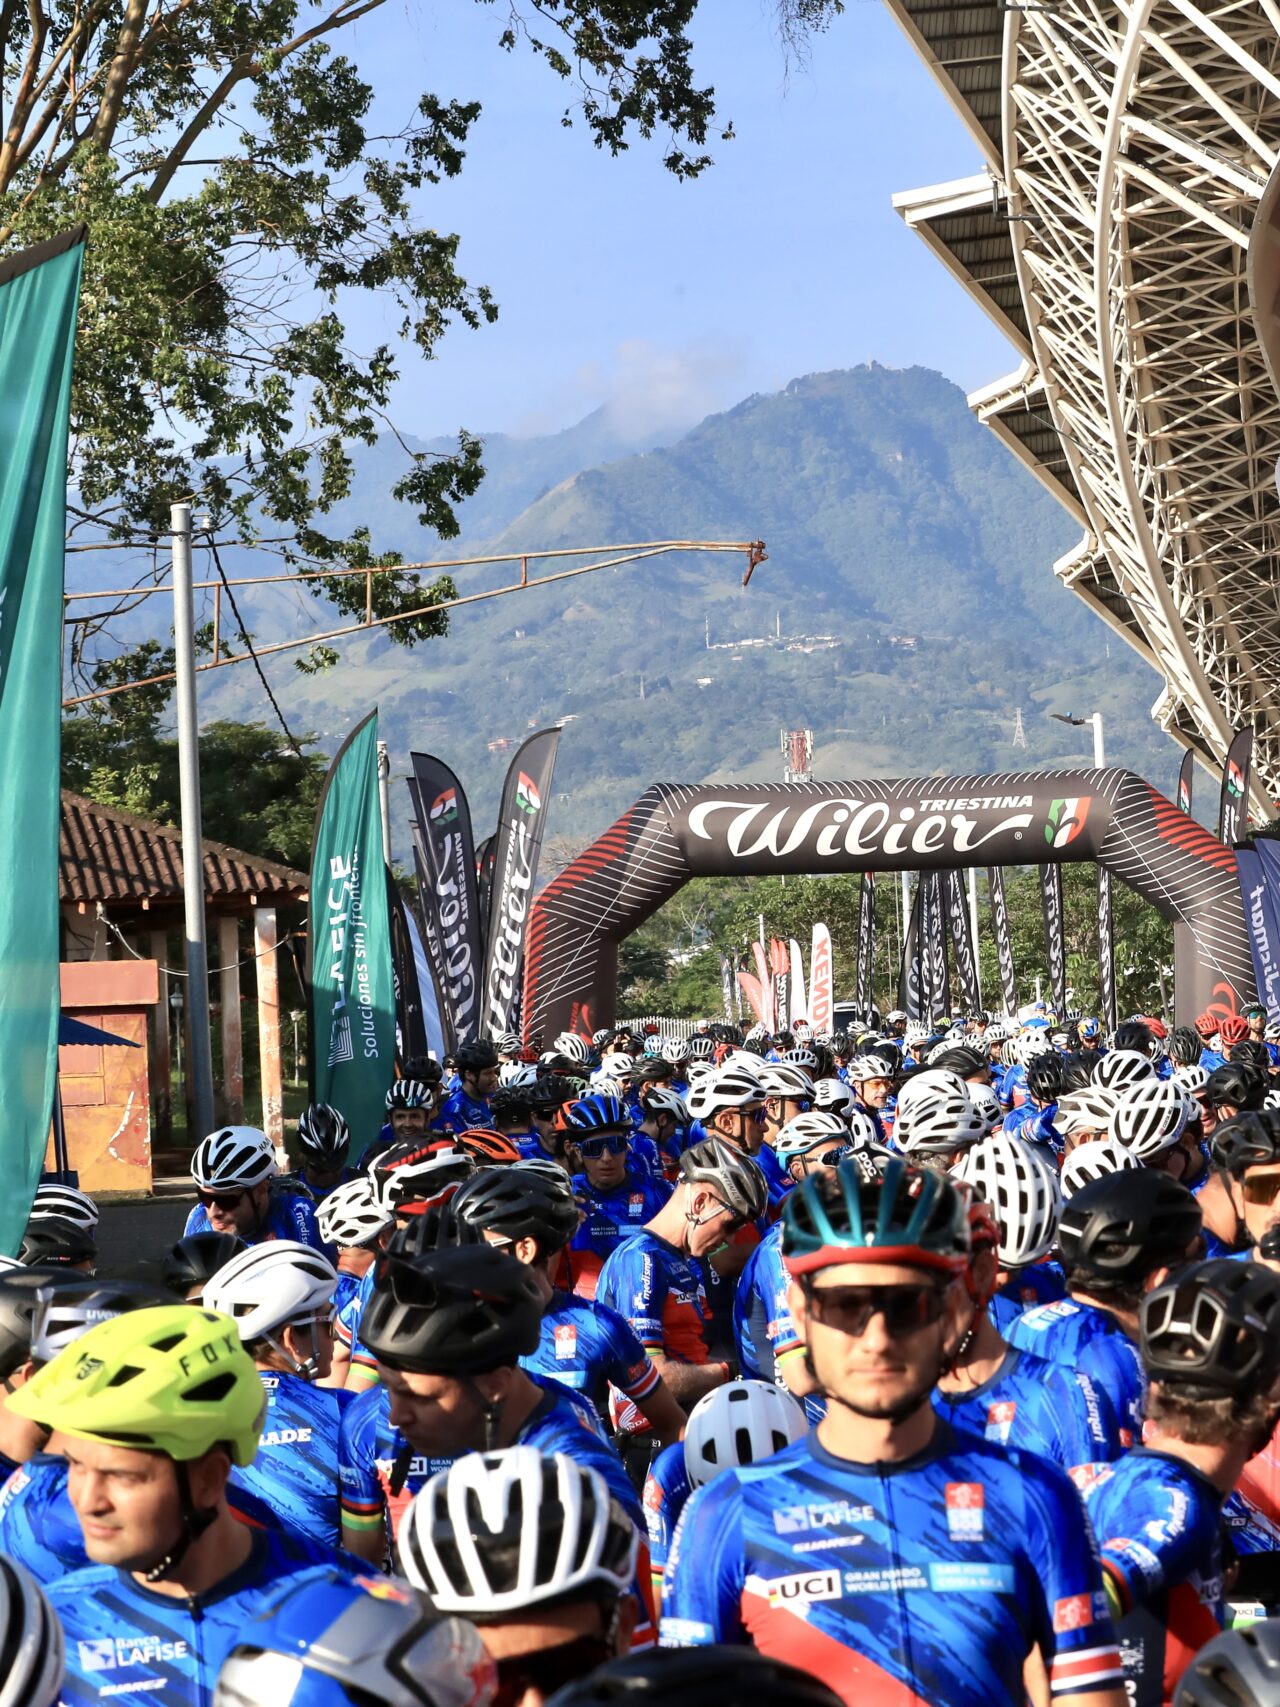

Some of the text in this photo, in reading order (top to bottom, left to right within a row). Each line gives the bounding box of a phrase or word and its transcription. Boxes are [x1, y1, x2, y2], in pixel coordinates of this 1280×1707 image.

[919, 795, 1034, 812] TRIESTINA
[688, 799, 1034, 858] Wilier
[350, 930, 367, 959] sin
[356, 962, 379, 1058] Soluciones
[178, 1336, 237, 1377] FOX
[809, 1505, 875, 1528] LAFISE
[845, 1571, 879, 1582] GRAN
[845, 1581, 890, 1592] WORLD
[780, 1577, 834, 1600] UCI
[116, 1636, 161, 1648] Banco
[117, 1641, 188, 1667] LAFISE
